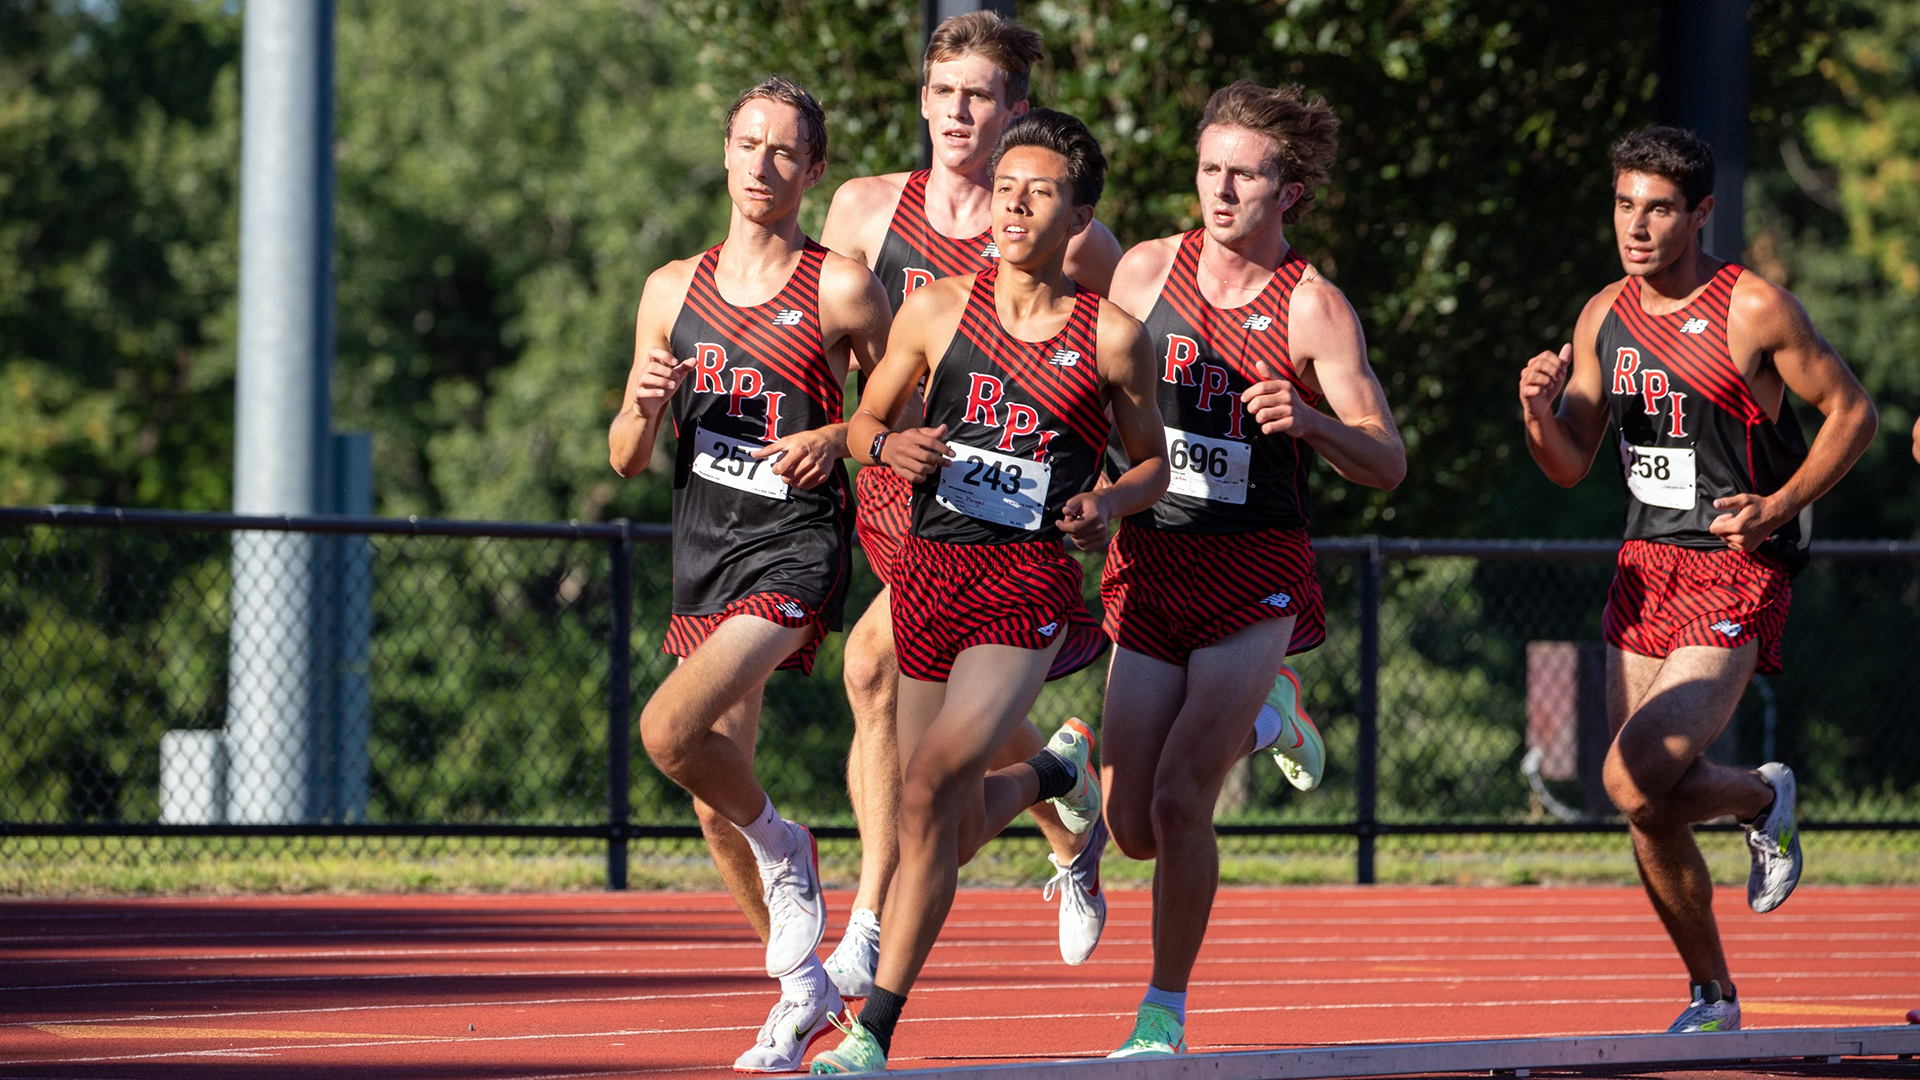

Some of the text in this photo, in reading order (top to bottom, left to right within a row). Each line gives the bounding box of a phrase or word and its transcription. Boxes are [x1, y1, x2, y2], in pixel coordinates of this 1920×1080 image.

[693, 342, 786, 442] RPI
[962, 372, 1060, 462] RPI
[1162, 333, 1247, 439] RPI
[1612, 347, 1688, 438] RPI
[710, 441, 769, 480] 257
[963, 455, 1023, 494] 243
[1170, 439, 1228, 478] 696
